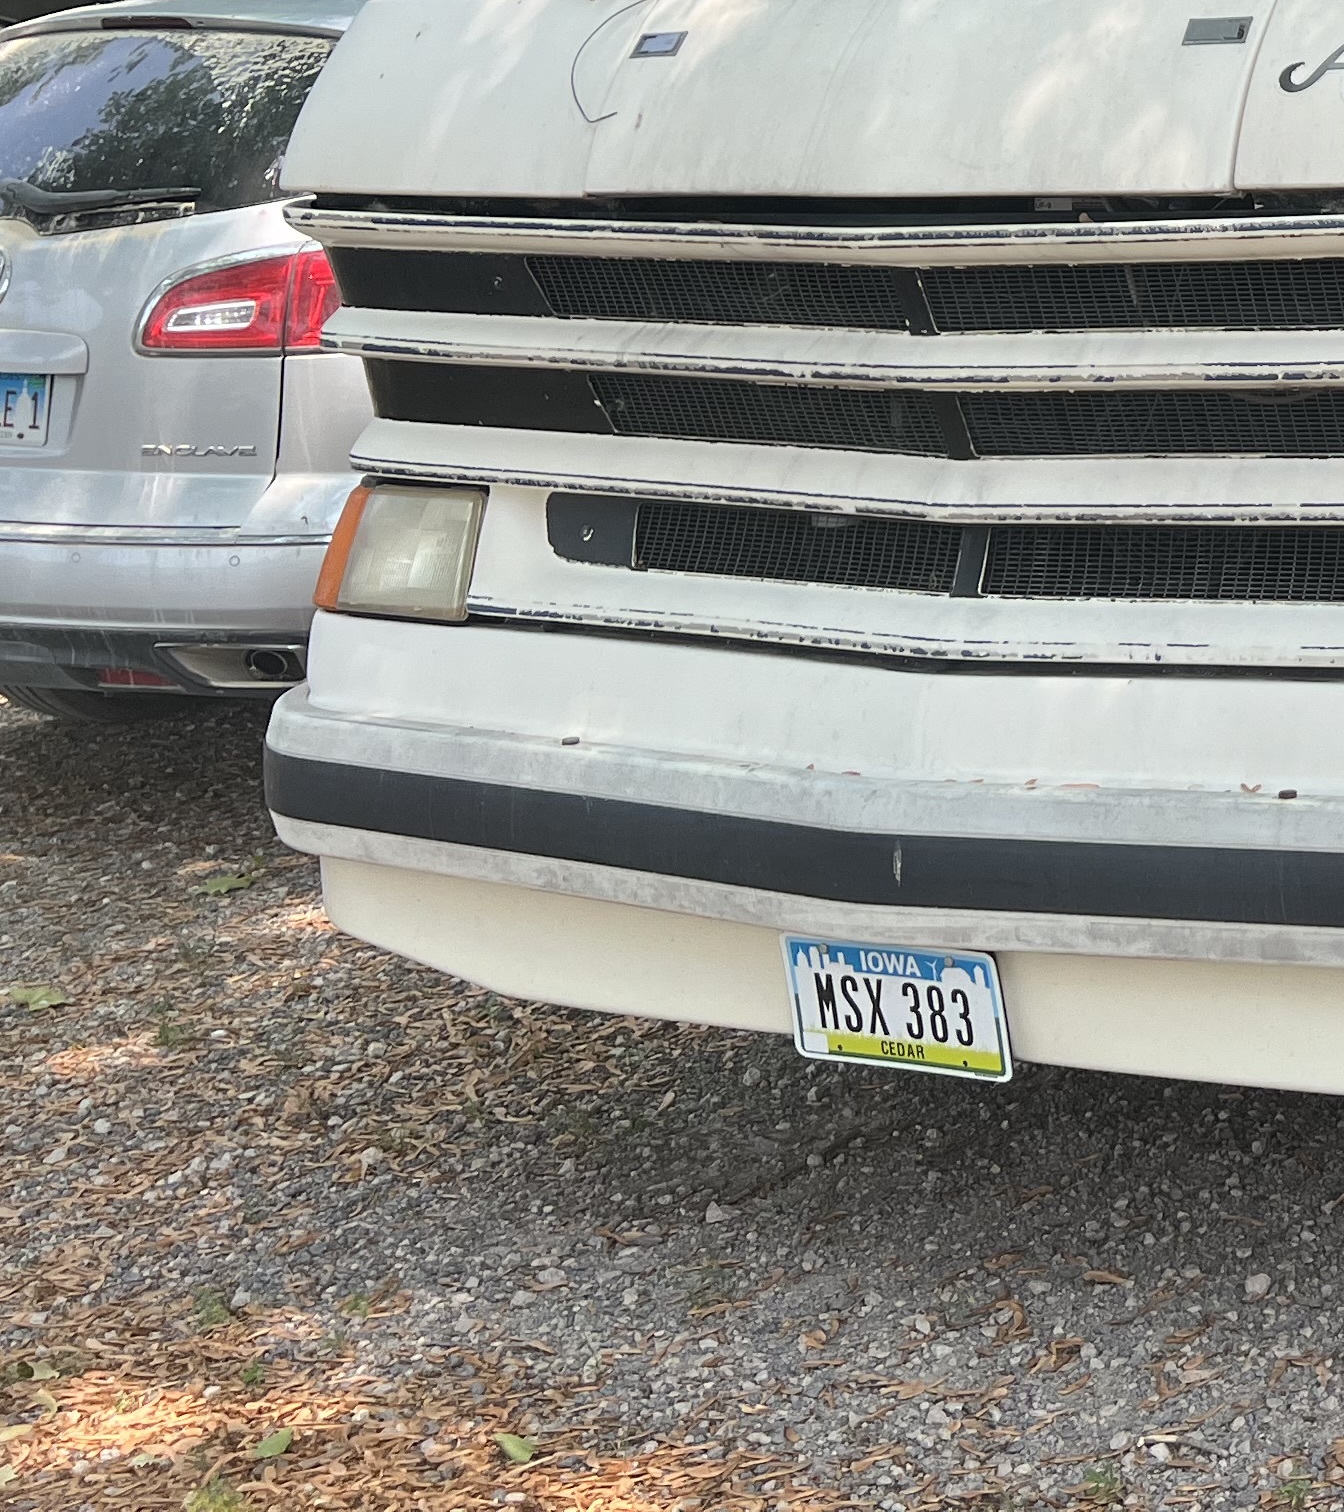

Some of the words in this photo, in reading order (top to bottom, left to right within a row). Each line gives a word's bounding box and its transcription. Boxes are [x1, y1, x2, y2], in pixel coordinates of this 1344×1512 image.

[140, 444, 258, 457] ENCLAVE
[859, 949, 922, 978] IOWA
[814, 972, 891, 1036] MSX
[901, 982, 974, 1047] 383
[880, 1040, 925, 1060] CEDAR
